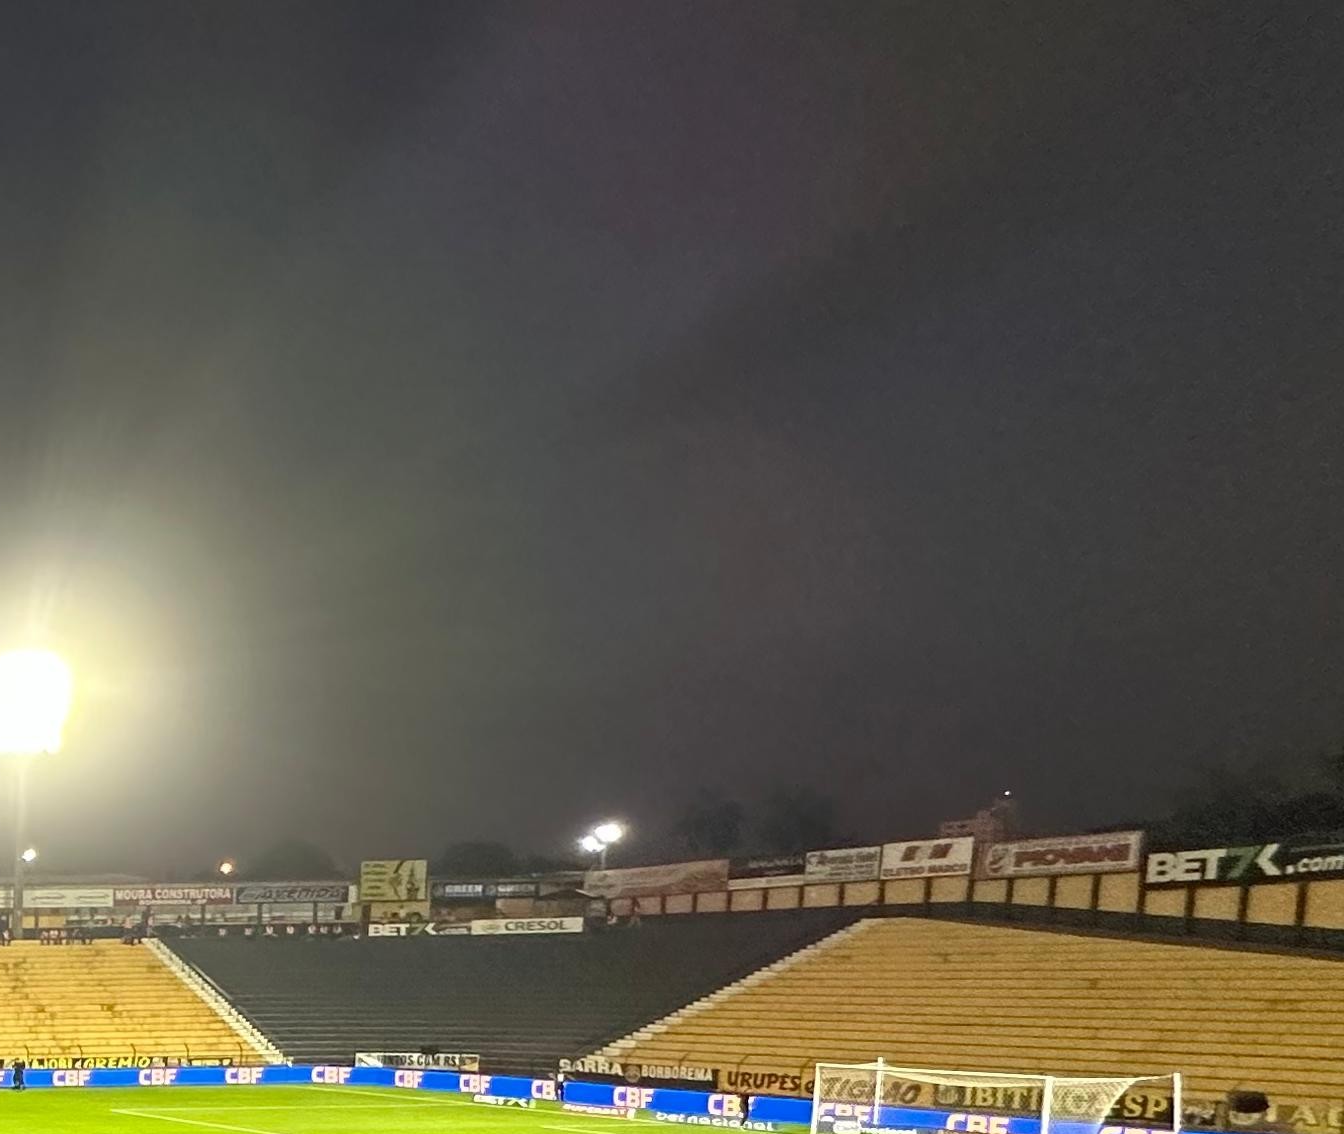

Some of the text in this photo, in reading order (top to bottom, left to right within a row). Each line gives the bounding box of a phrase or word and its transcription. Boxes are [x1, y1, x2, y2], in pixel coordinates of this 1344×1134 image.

[504, 921, 565, 932] CRESOL
[52, 1069, 92, 1087] CBF
[138, 1068, 179, 1086] CBF
[225, 1067, 265, 1085] CBF
[311, 1066, 352, 1085] CBF
[394, 1070, 425, 1088] CBF
[640, 1064, 714, 1082] BORBOREMA
[459, 1073, 492, 1094] CBF
[612, 1085, 654, 1110] CBF
